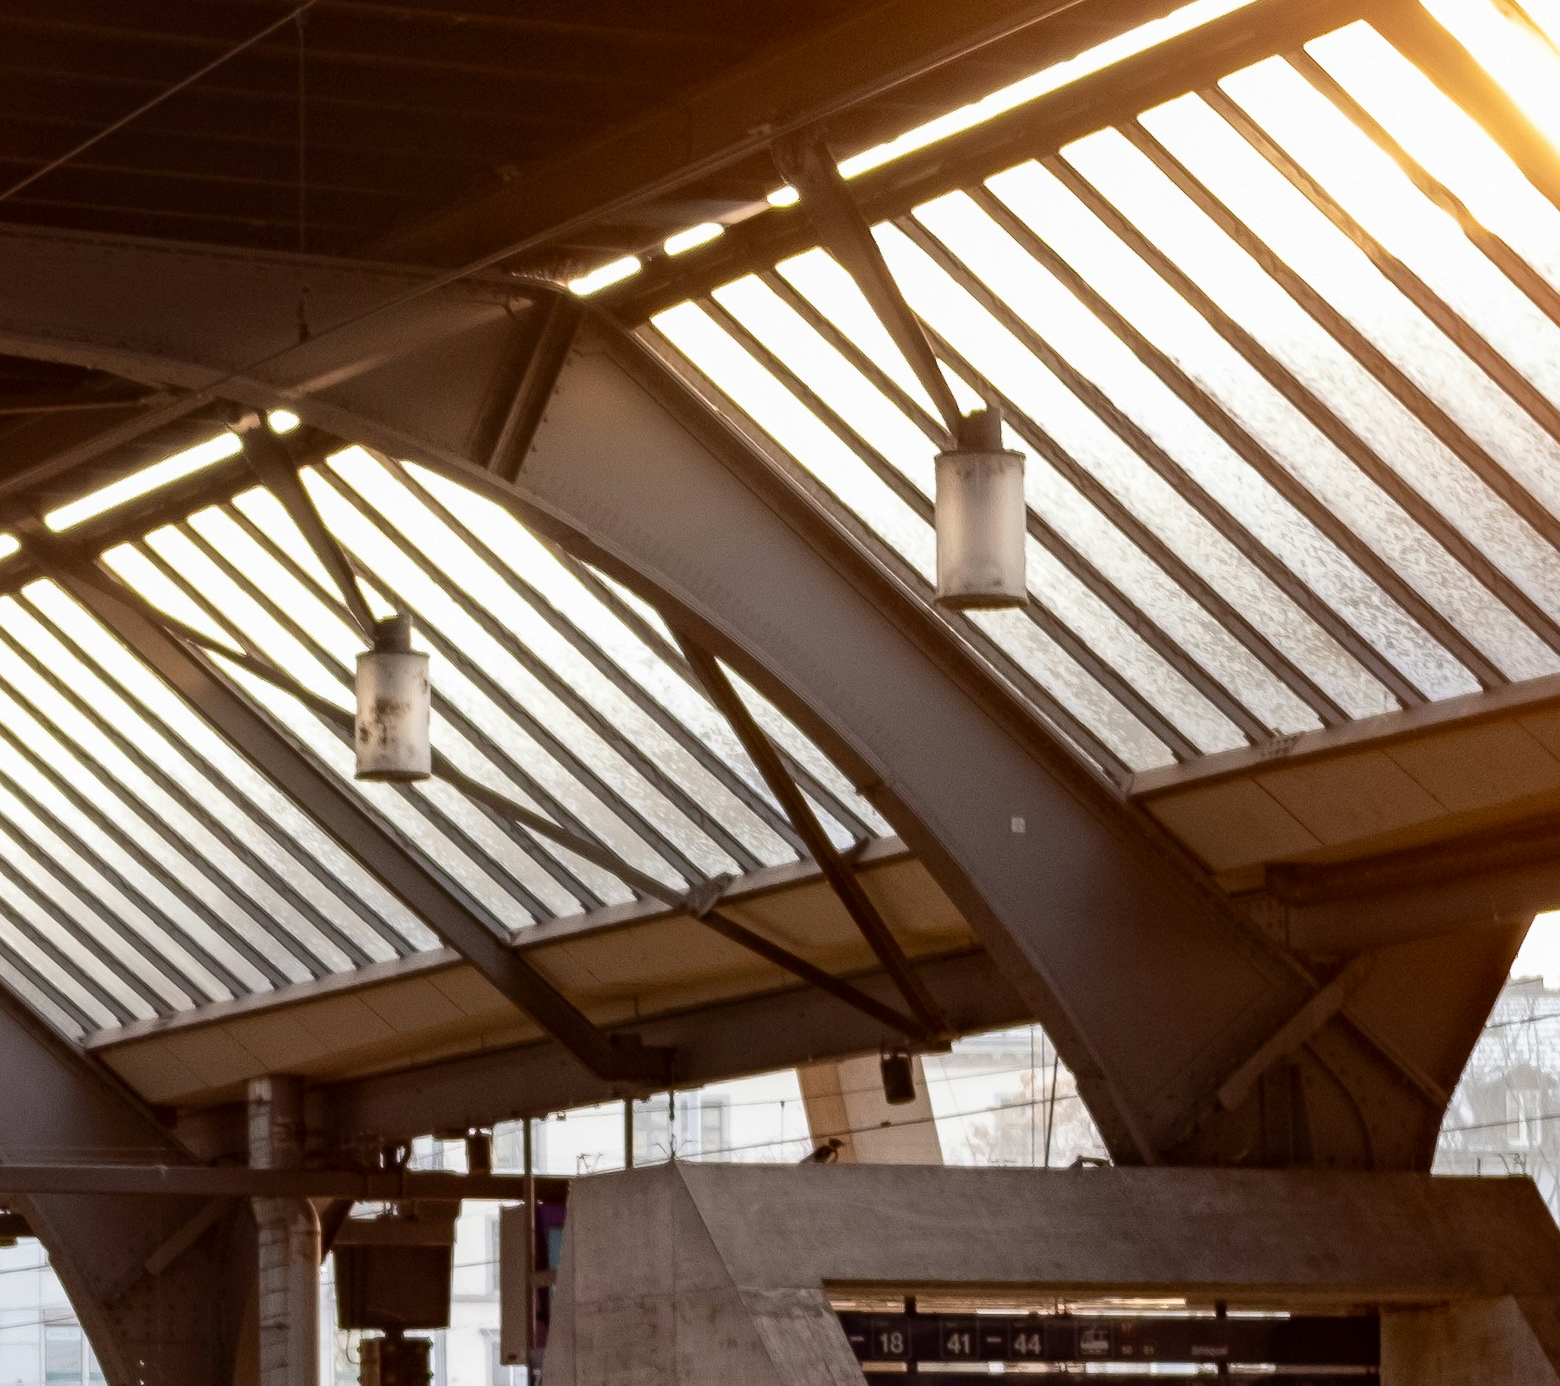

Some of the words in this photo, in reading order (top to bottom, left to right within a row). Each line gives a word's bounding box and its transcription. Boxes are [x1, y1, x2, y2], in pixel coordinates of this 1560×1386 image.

[879, 1332, 904, 1354] 18
[947, 1332, 971, 1355] 41
[1014, 1332, 1042, 1355] 44
